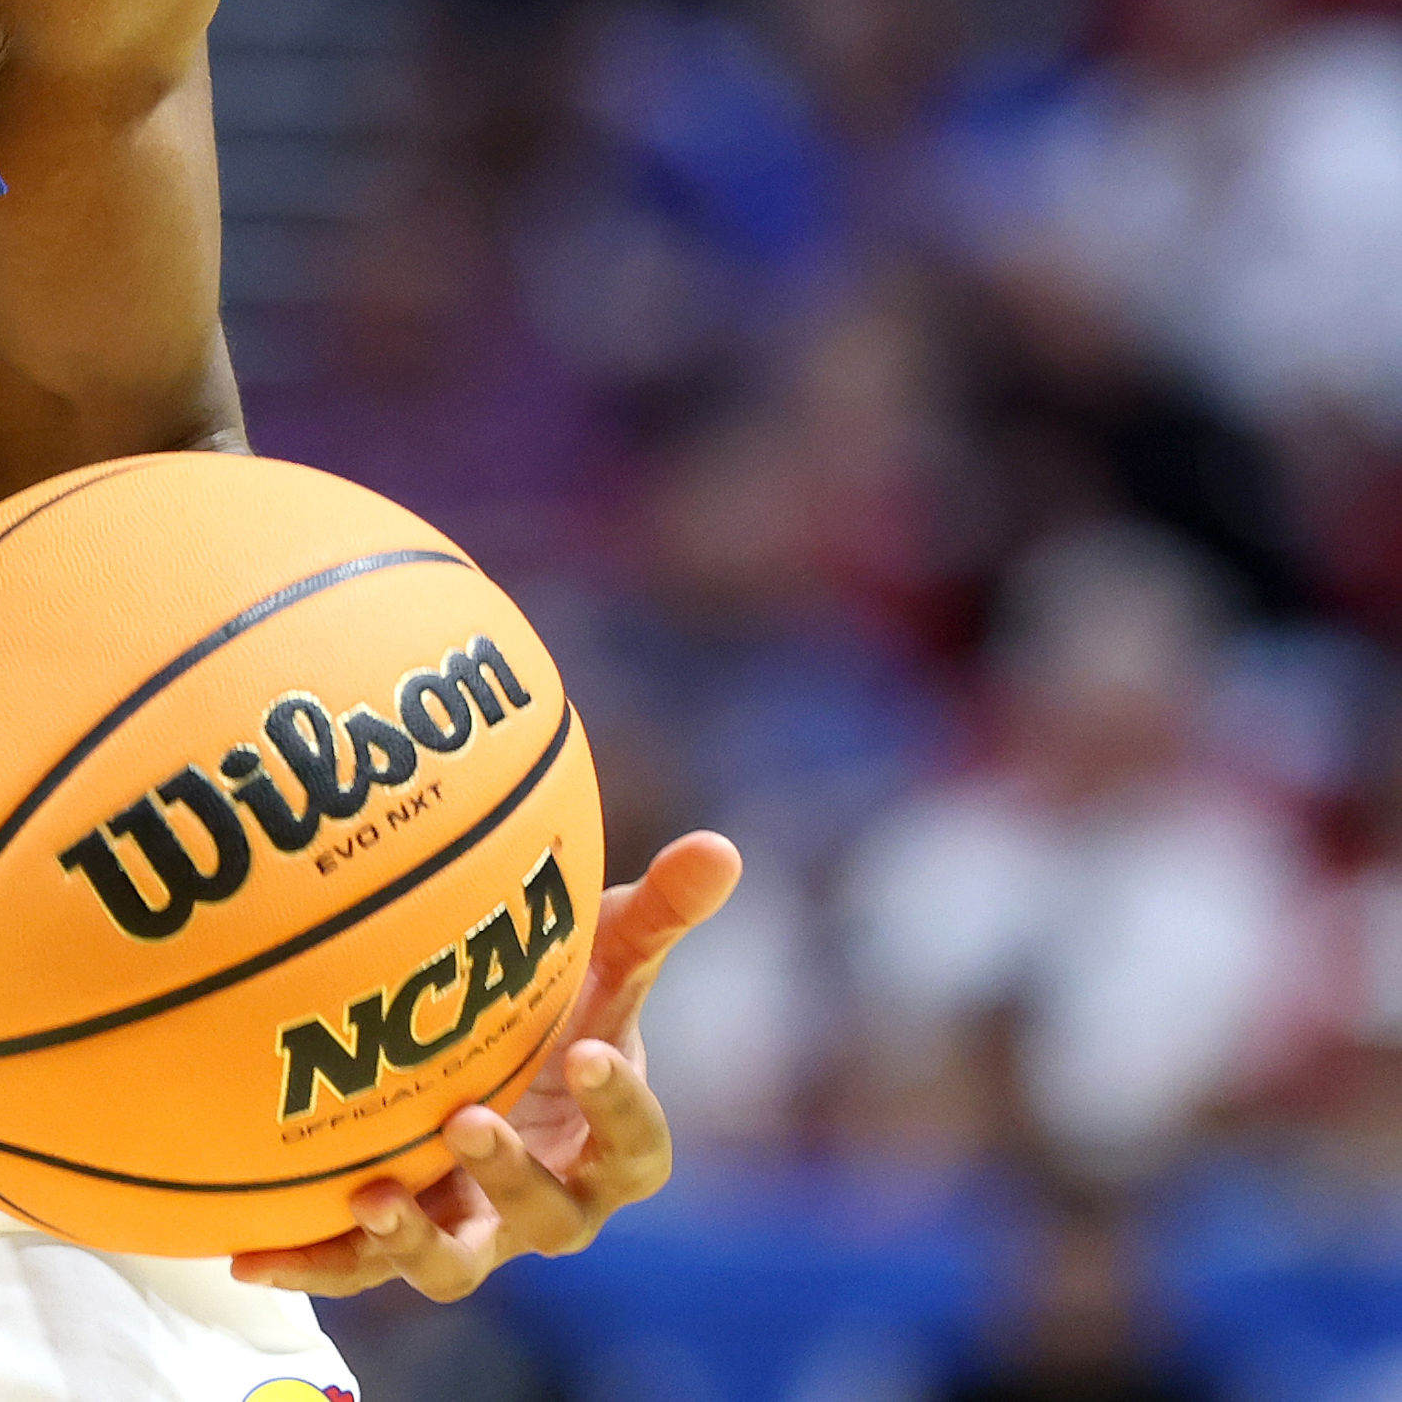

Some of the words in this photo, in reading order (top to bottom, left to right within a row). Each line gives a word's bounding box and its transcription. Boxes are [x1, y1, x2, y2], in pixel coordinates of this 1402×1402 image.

[58, 633, 532, 944] Wilson
[314, 823, 380, 876] EVO
[386, 782, 443, 832] NXT
[276, 844, 578, 1123] NCAA
[281, 1079, 435, 1144] OFFICIAL
